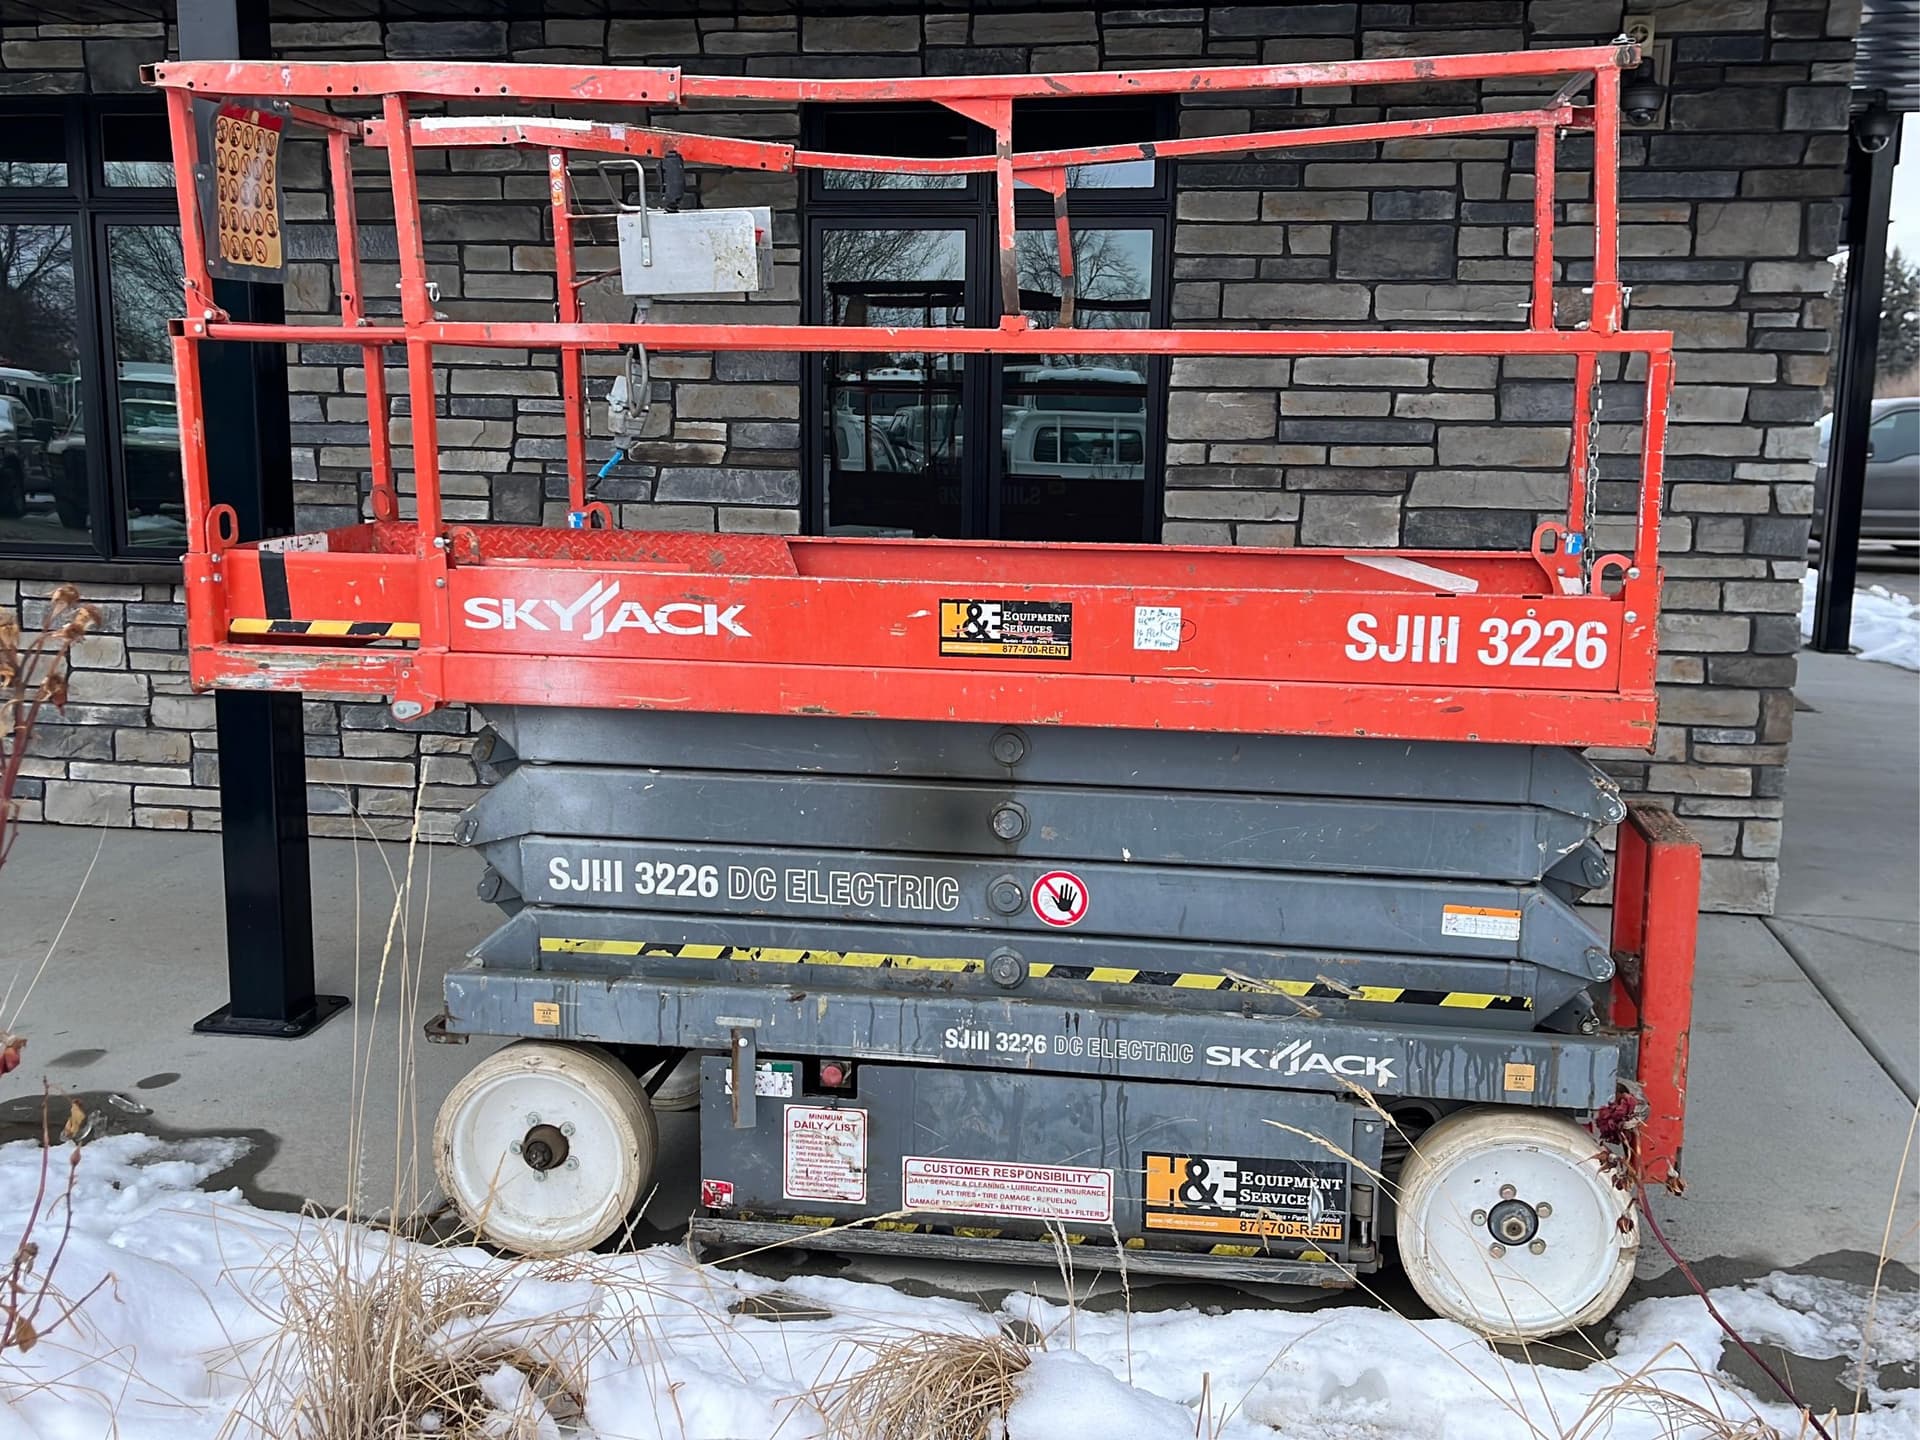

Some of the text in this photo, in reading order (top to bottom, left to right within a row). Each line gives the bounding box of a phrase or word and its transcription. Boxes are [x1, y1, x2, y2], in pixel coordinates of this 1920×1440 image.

[463, 579, 752, 641] SKYJACK
[1002, 611, 1070, 622] EQUIPMENT
[941, 602, 1001, 640] H&E
[1002, 623, 1052, 634] SERVICES
[1002, 645, 1068, 655] 877-700-RENT
[1345, 612, 1608, 669] SJIII 3226
[548, 857, 960, 912] SJIII 3226 DC ELECTRIC
[996, 1032, 1047, 1054] 3226
[1054, 1035, 1084, 1056] DC
[1088, 1038, 1194, 1064] ELECTRIC
[1206, 1040, 1398, 1079] SKYJACK
[794, 1120, 857, 1132] DAILY LIST
[924, 1164, 1091, 1183] CUSTOMER RESPONSIBILITY
[1146, 1155, 1238, 1211] H&E
[1240, 1171, 1343, 1190] EQUIPMENT
[1011, 1184, 1058, 1192] LUBRICATION
[1065, 1188, 1106, 1196] INSURANCE
